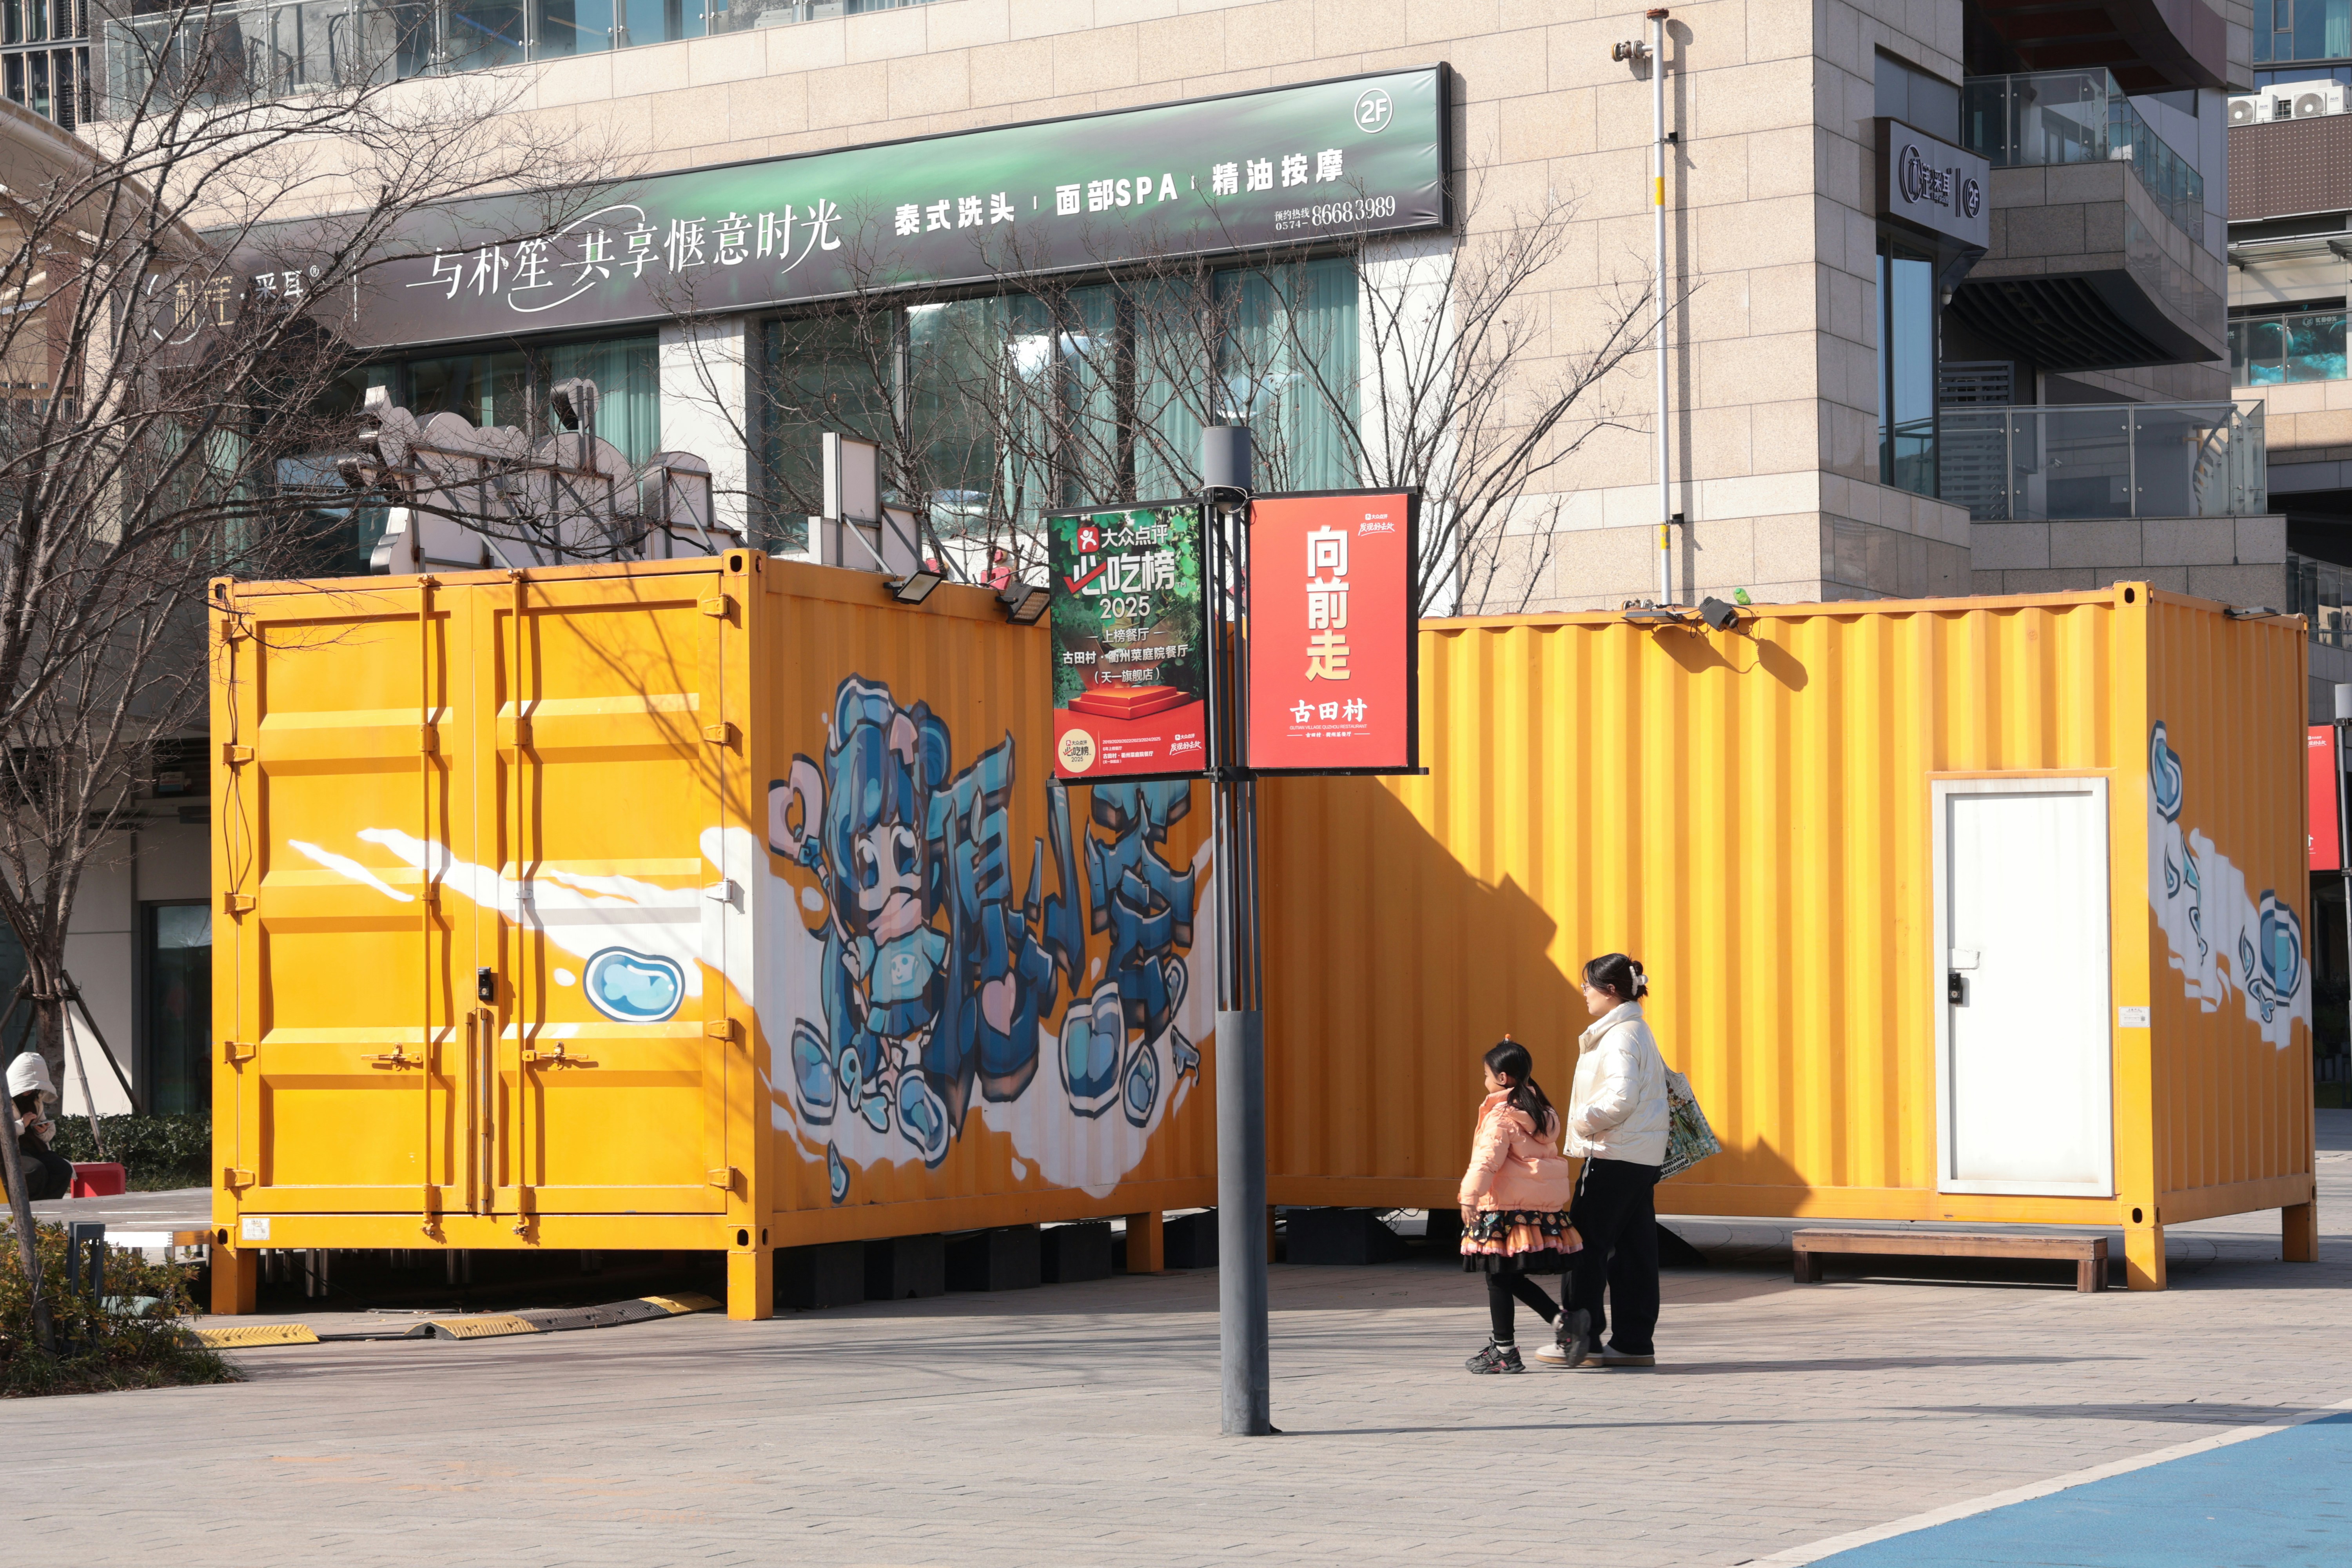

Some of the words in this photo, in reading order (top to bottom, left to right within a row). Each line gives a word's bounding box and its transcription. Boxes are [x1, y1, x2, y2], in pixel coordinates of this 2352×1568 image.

[1360, 98, 1387, 123] 2F
[895, 192, 1015, 236] 泰式洗头
[1055, 173, 1178, 216] 面部SPA
[1212, 148, 1344, 196] 精油按摩
[1969, 187, 1978, 208] 2F
[1274, 207, 1310, 222] 预约热线
[1276, 221, 1308, 230] 0574-
[1101, 524, 1168, 548] 大众点评
[1358, 522, 1395, 536] 发现好去处
[1063, 550, 1175, 595] 必吃榜
[1099, 595, 1151, 619] 2025
[1305, 525, 1351, 681] 向前走
[1102, 627, 1150, 643] 上榜餐厅
[1289, 697, 1368, 724] 古田村
[1063, 746, 1089, 757] 必吃榜
[1169, 740, 1202, 755] 发现好去处
[1661, 1154, 1685, 1169] emake
